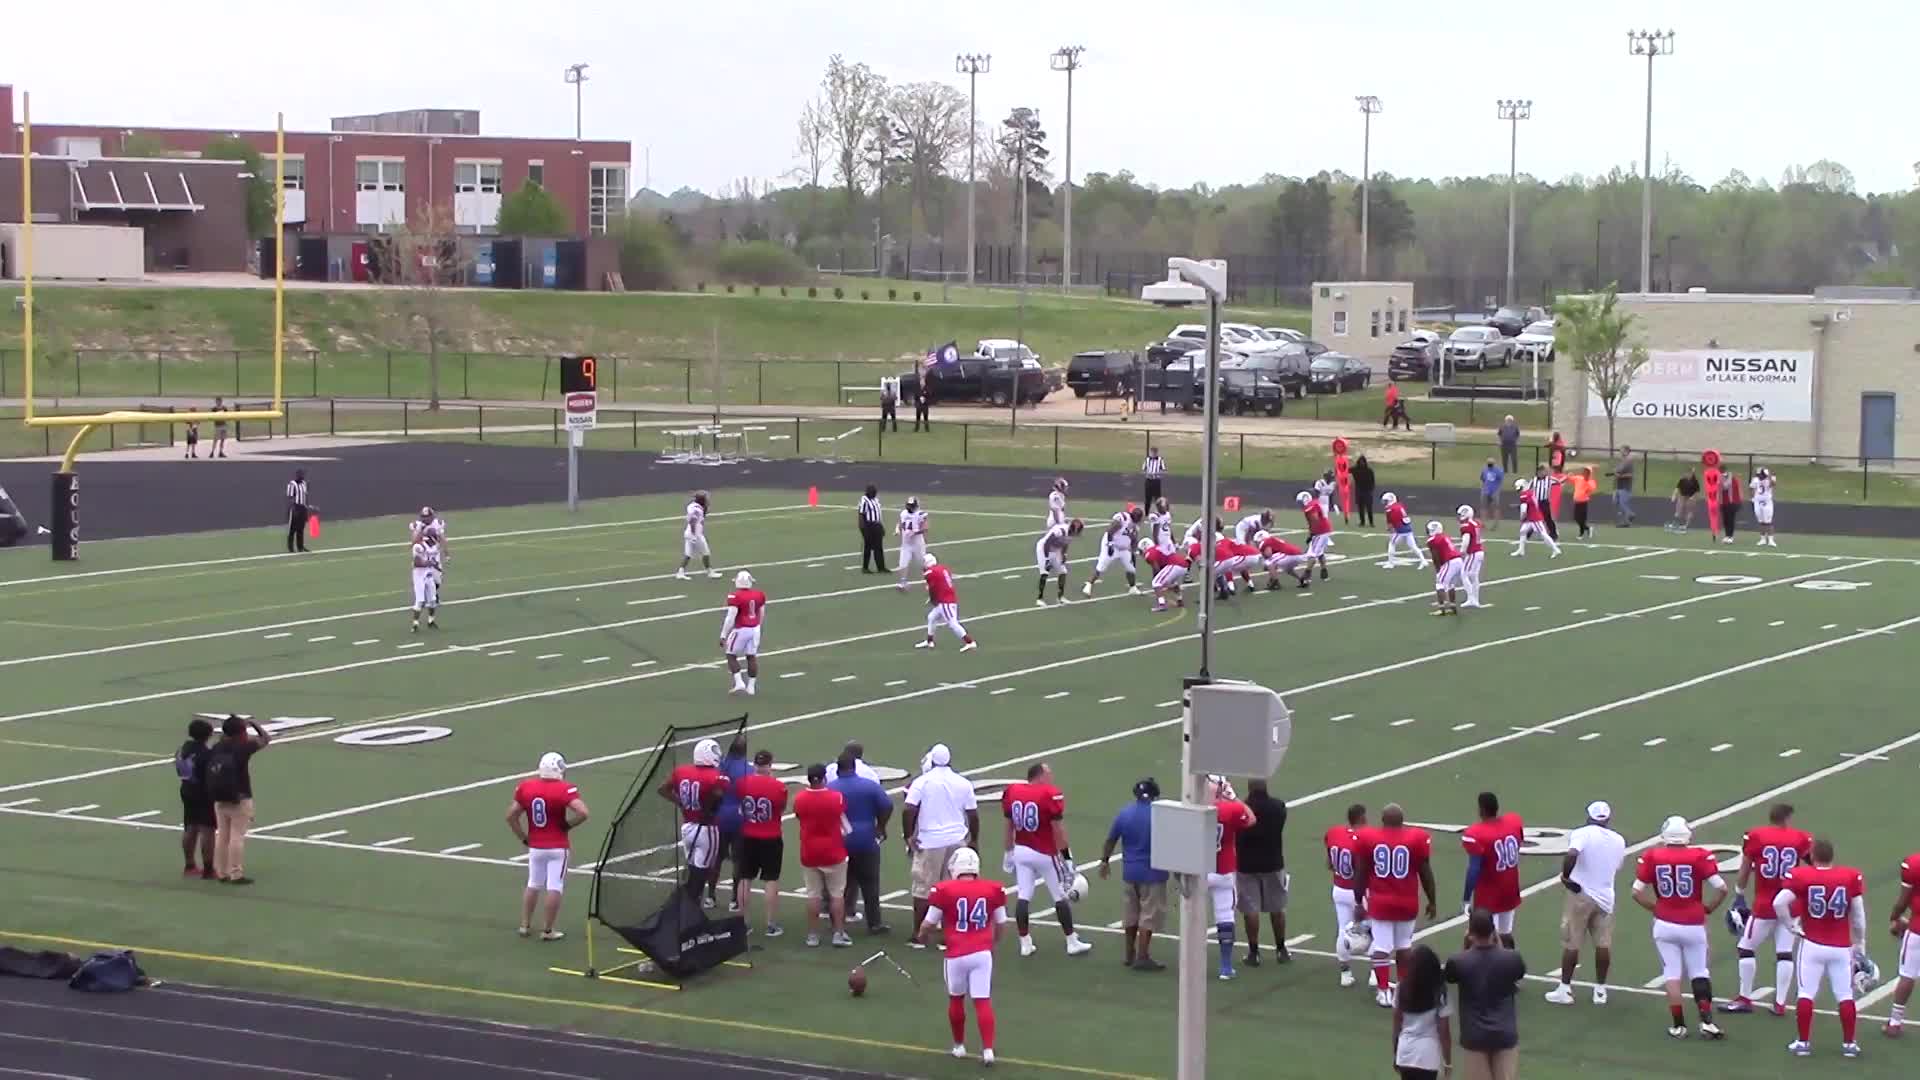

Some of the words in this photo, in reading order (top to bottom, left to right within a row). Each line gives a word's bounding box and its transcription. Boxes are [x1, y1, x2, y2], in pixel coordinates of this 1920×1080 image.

[582, 359, 594, 387] 9
[1706, 358, 1797, 372] NISSAN
[1706, 374, 1716, 382] of
[1718, 374, 1746, 383] LAKE
[1749, 374, 1797, 383] NORMAN
[1632, 402, 1658, 417] GO
[1663, 403, 1744, 418] HUSKIES!
[532, 797, 547, 828] 8
[743, 795, 773, 824] 23
[1373, 844, 1409, 879] 90
[1494, 835, 1520, 873] 10
[1760, 846, 1798, 879] 32
[1655, 865, 1693, 898] 55
[956, 897, 988, 932] 14
[1808, 886, 1848, 918] 54
